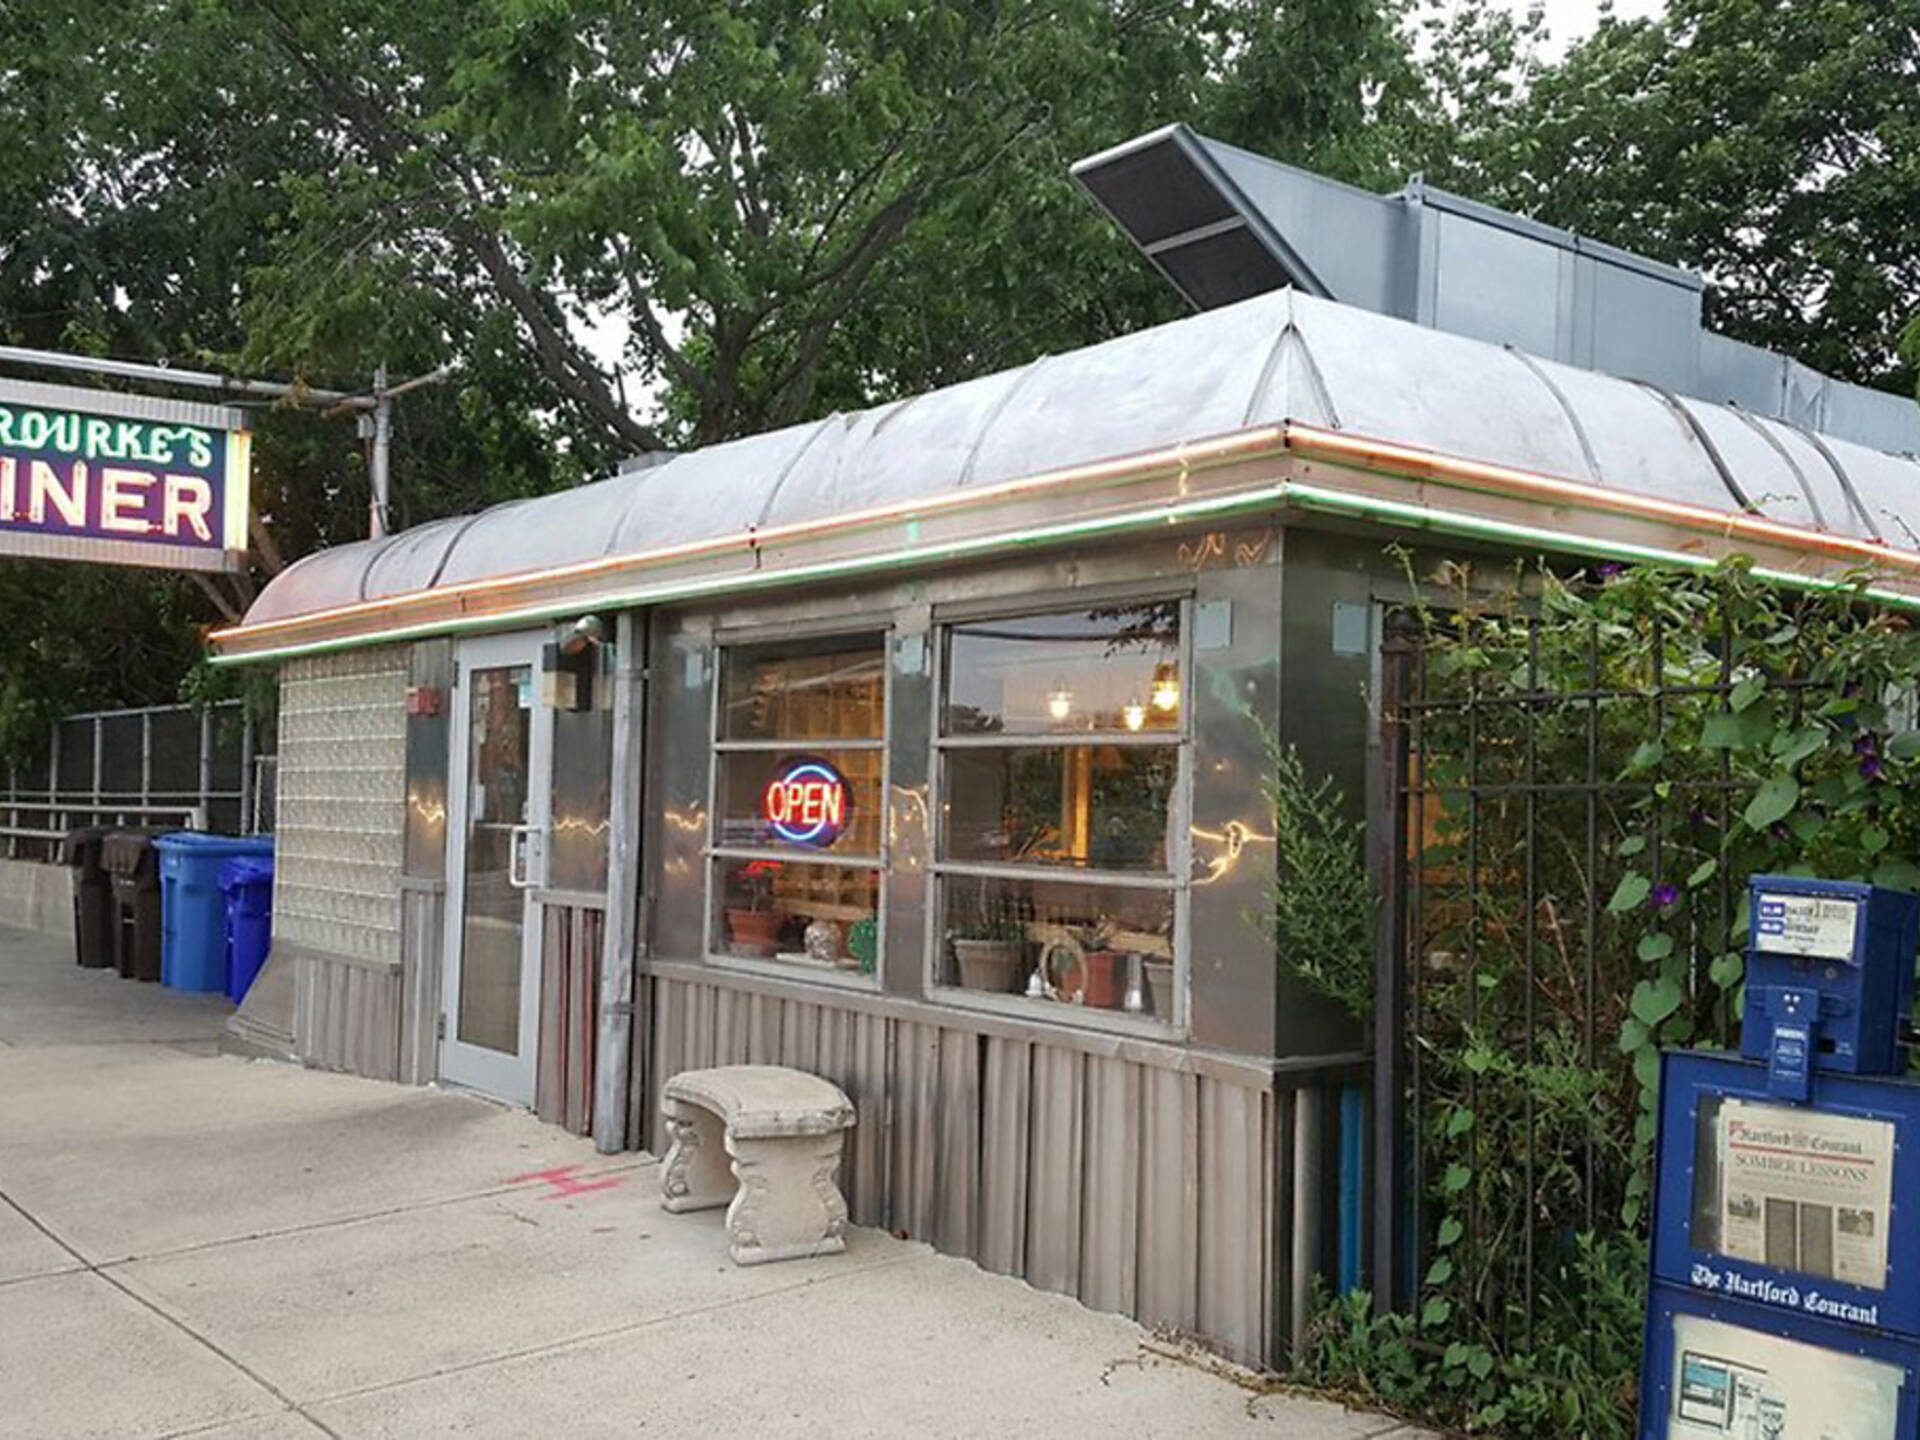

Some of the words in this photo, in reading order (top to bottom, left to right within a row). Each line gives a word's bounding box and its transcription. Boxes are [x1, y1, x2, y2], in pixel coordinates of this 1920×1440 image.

[767, 781, 842, 825] OPEN
[1691, 1264, 1721, 1289] The
[1726, 1272, 1799, 1307] Hartford
[1804, 1289, 1878, 1325] Courant
